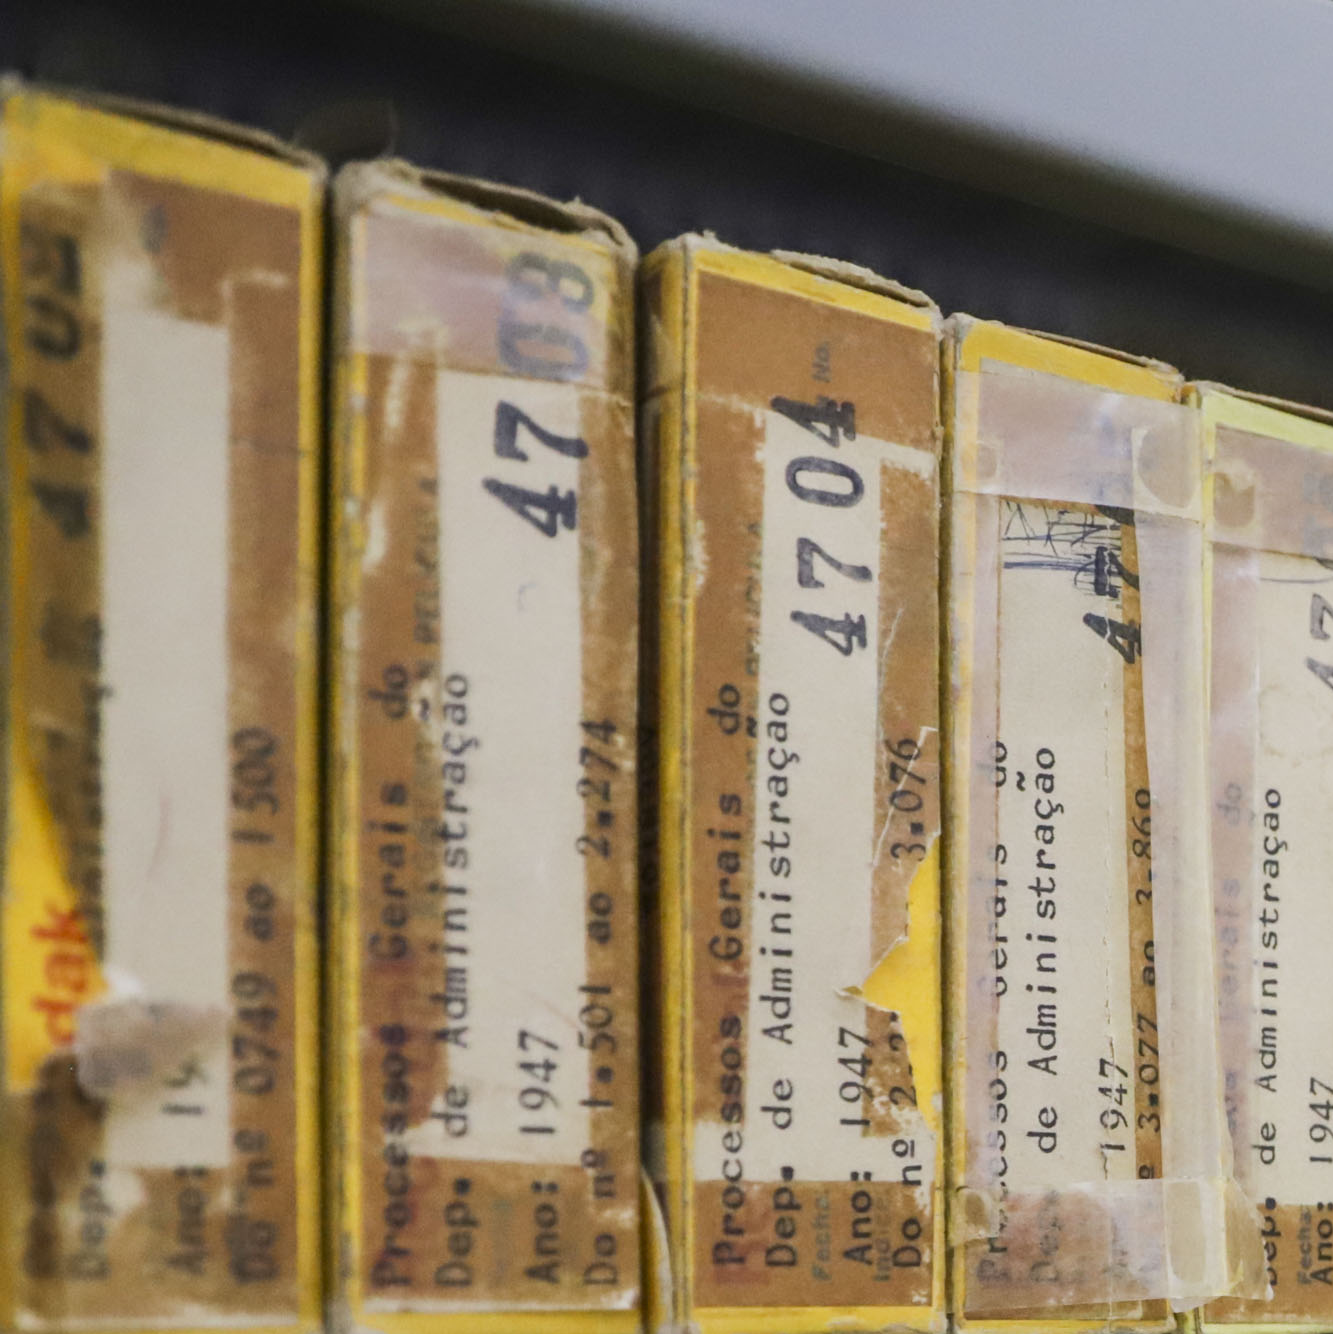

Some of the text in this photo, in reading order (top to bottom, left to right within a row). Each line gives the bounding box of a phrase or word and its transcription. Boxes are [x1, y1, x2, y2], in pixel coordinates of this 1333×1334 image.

[481, 398, 590, 538] 47
[883, 735, 926, 864] 3.076
[970, 740, 1010, 790] do
[240, 884, 280, 944] ao
[416, 672, 482, 1051] Administração
[746, 690, 802, 1047] Administração
[1014, 748, 1066, 1078] Administração
[366, 661, 416, 1291] Processos Gerais do
[704, 682, 746, 1267] Processos Gerais do
[1246, 786, 1290, 1093] Administração
[230, 969, 280, 1098] 0749
[576, 718, 622, 1288] Do nº 1.501 ao 2.274
[428, 1082, 472, 1139] de
[758, 1077, 796, 1132] de
[1022, 1105, 1060, 1155] de
[1096, 1056, 1132, 1154] 1947
[1134, 1012, 1164, 1135] 3.077
[516, 1027, 564, 1287] Ano: 1947
[836, 1026, 876, 1267] Ano: 1947
[888, 1137, 924, 1187] nº
[1248, 1120, 1280, 1165] de
[433, 1174, 480, 1290] Dep.
[762, 1166, 802, 1270] Dep.
[890, 1216, 925, 1270] Do
